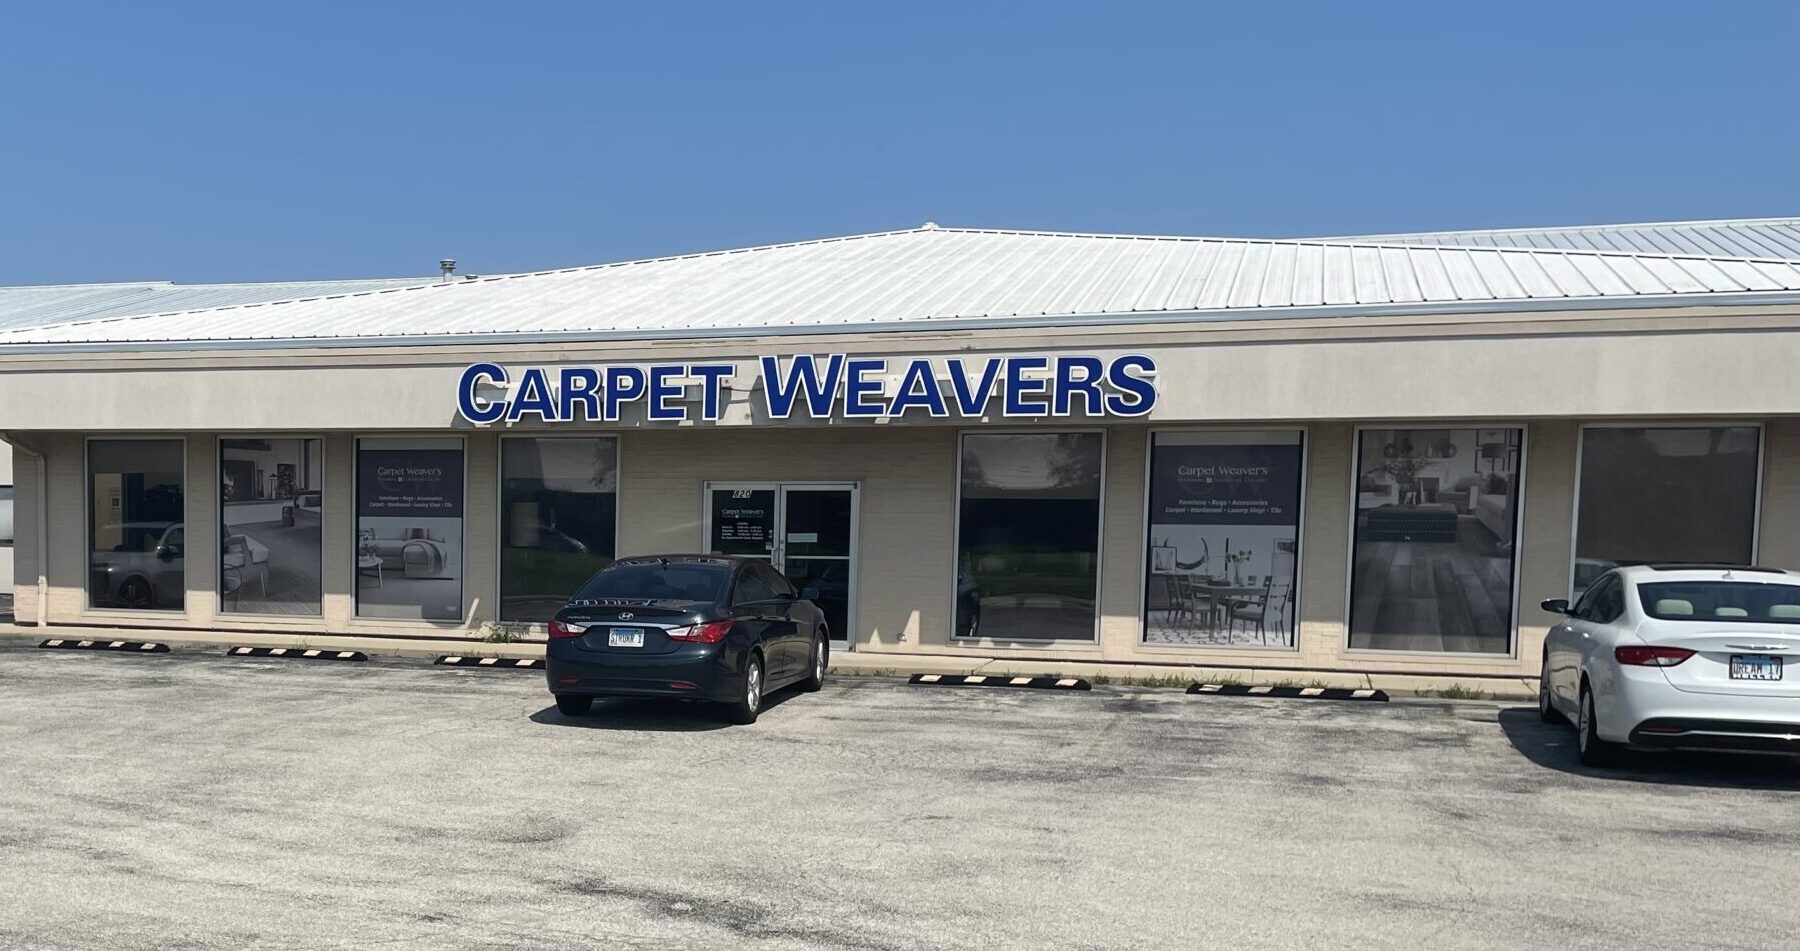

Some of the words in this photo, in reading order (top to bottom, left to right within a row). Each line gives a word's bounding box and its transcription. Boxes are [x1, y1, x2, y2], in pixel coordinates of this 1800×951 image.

[457, 361, 738, 425] CARPET
[759, 353, 1160, 419] WEAVERS
[377, 467, 404, 477] Carpet
[1178, 466, 1215, 477] Carpet
[1218, 466, 1268, 476] Weaver's
[733, 490, 751, 498] 820
[1211, 499, 1228, 507] Rugs
[1165, 506, 1186, 514] Carpet
[1733, 661, 1763, 675] DREAM
